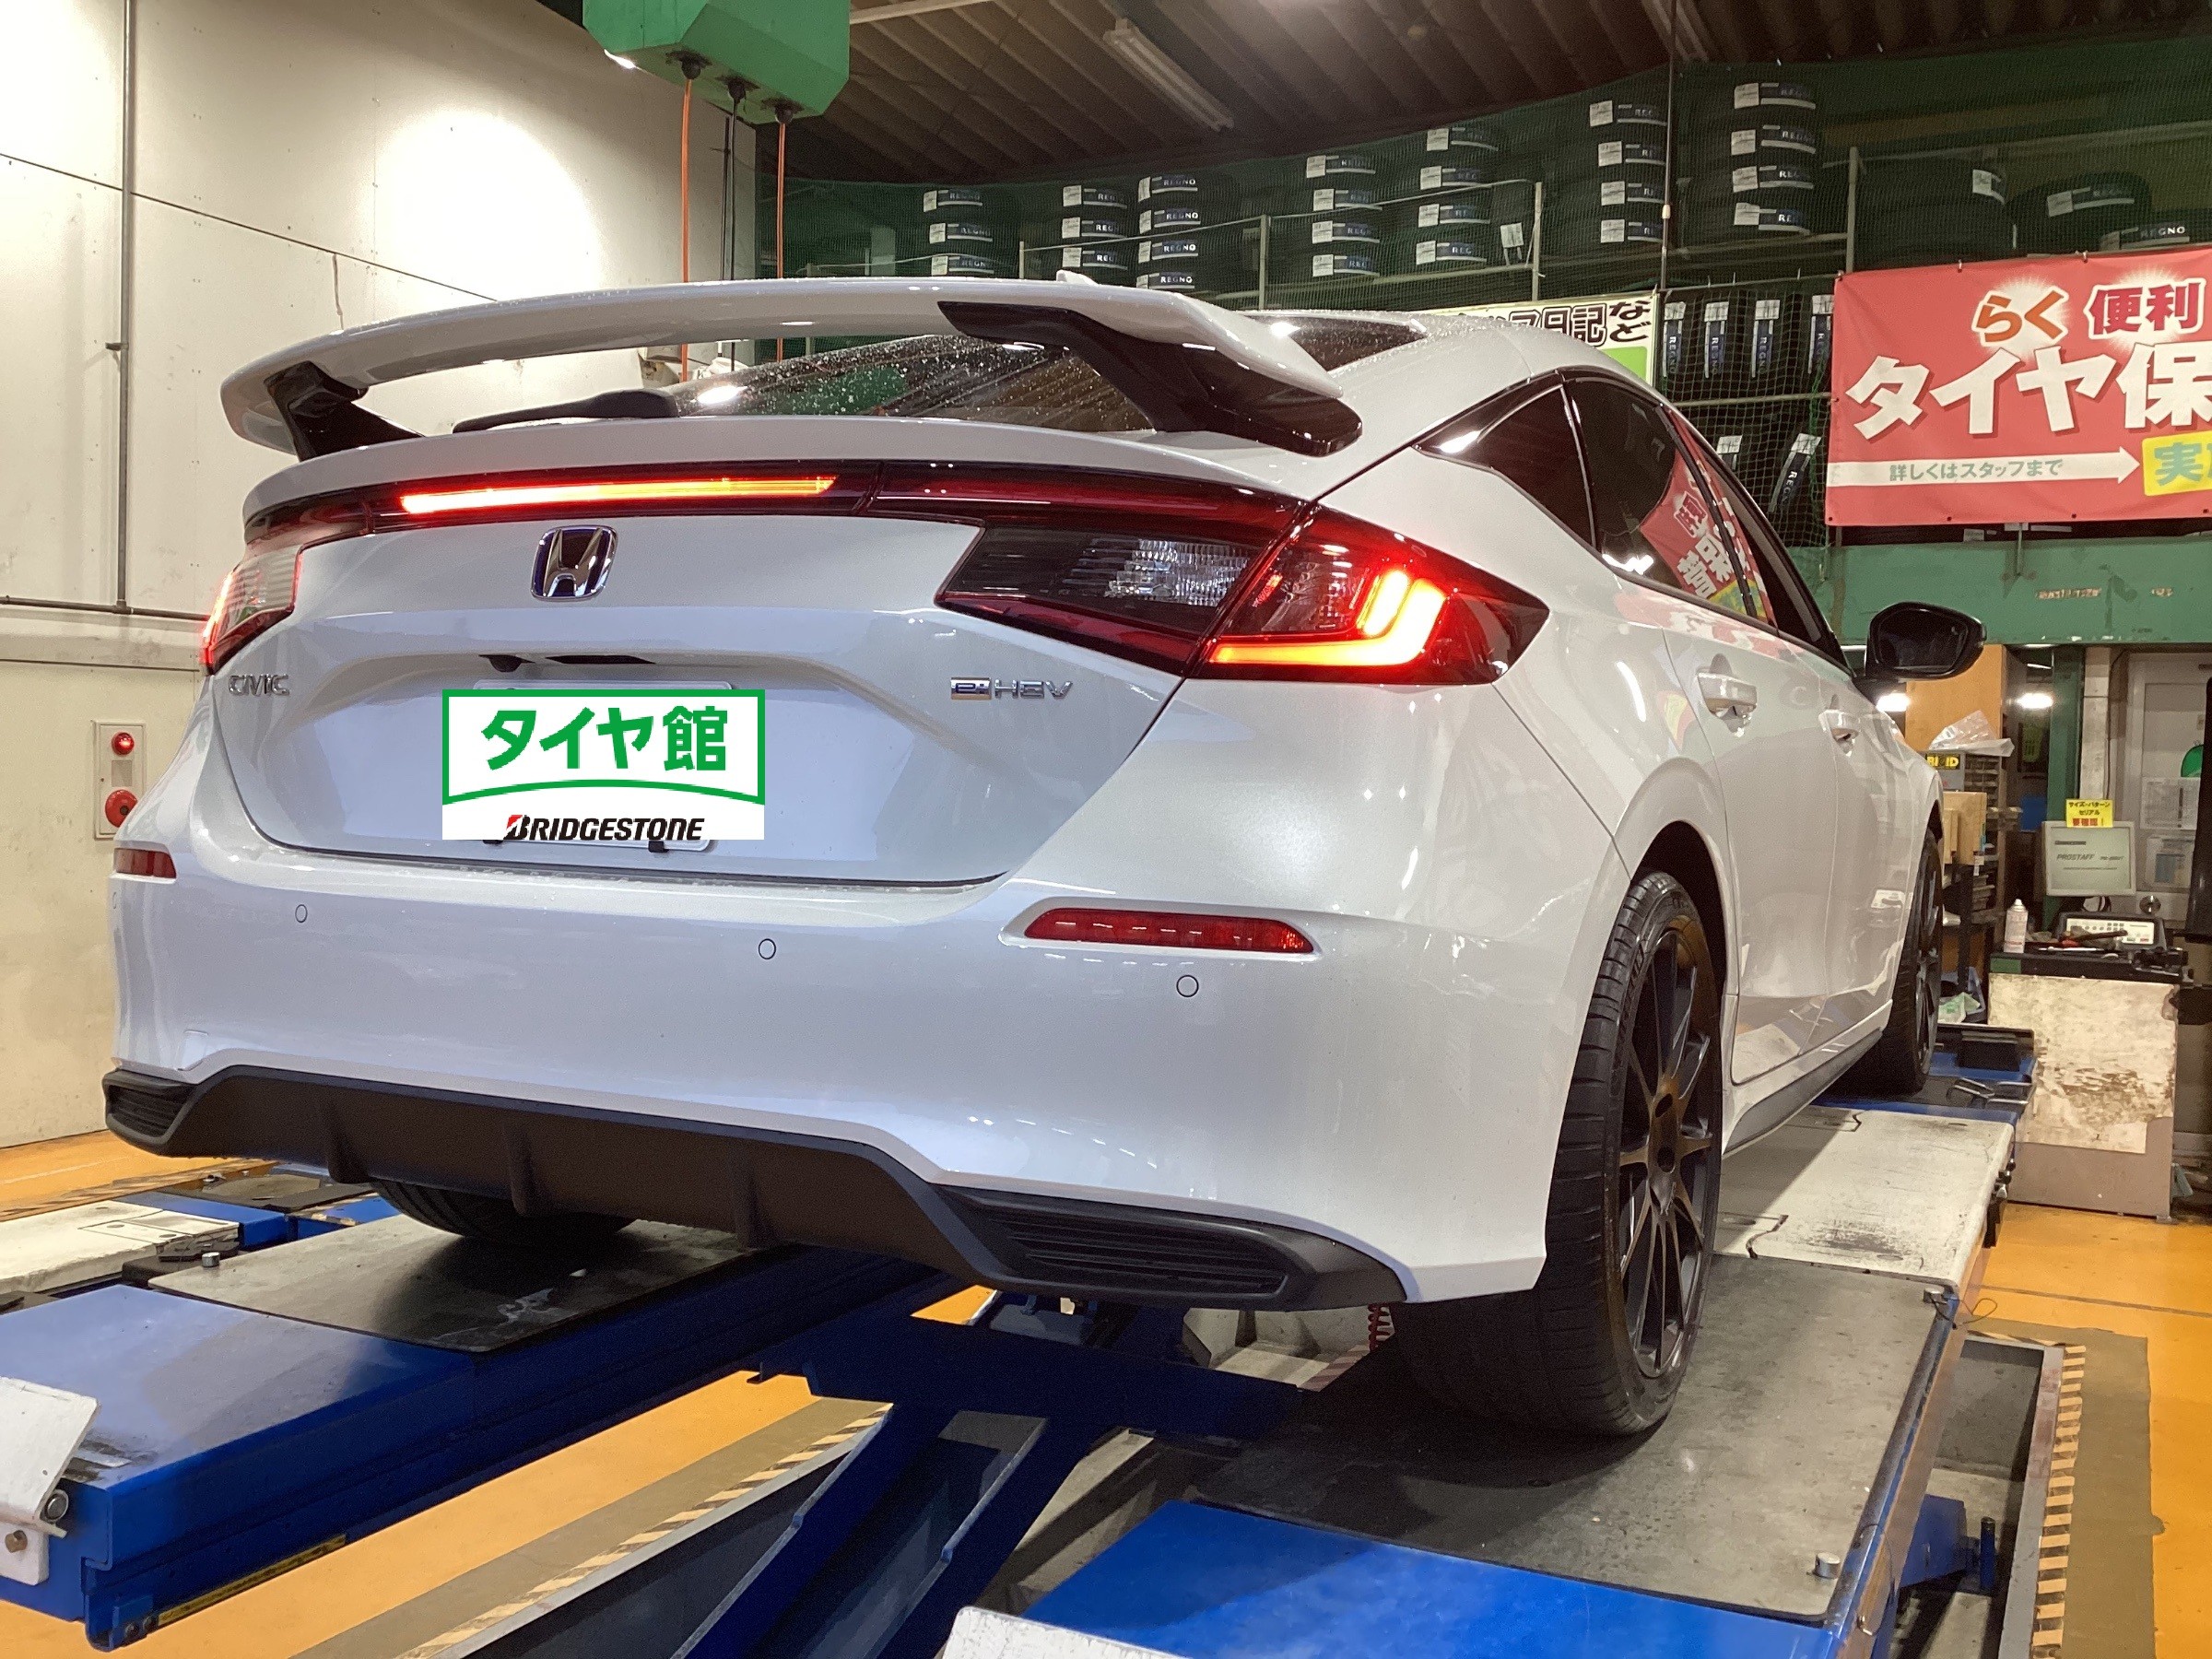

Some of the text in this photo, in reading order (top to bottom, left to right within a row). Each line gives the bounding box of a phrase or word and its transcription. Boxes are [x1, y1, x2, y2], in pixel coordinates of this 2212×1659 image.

[1166, 212, 1199, 220] REGNO
[1163, 243, 1196, 252] REGNO
[1160, 276, 1193, 284] REGNO
[1973, 280, 2206, 347] らく 便利
[1846, 343, 2212, 440] タイヤ保
[1889, 460, 2064, 482] 詳しくはスタッフまで
[2154, 441, 2212, 488] 実
[229, 674, 290, 697] CIVIC
